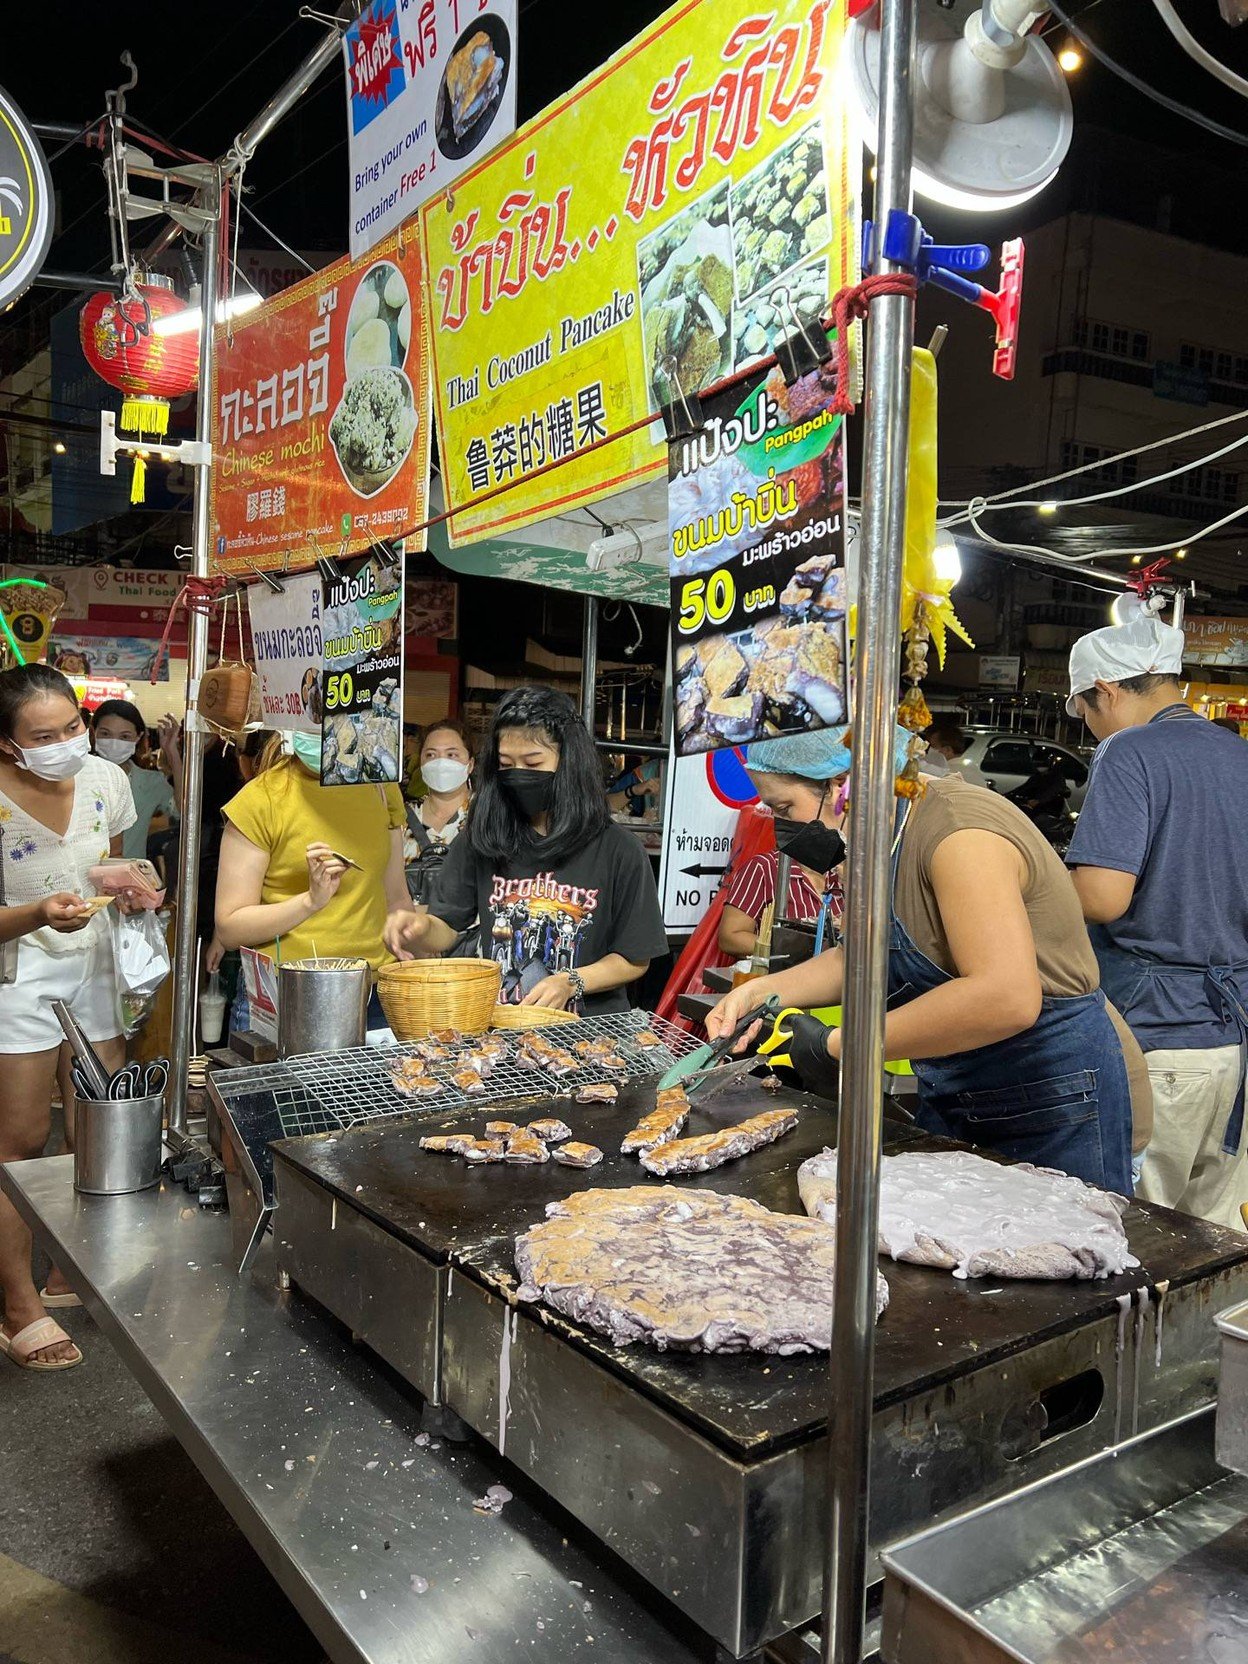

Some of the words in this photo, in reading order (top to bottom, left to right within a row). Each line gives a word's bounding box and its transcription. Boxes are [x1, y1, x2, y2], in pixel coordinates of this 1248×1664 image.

[355, 162, 380, 193] Bring
[381, 144, 403, 176] your
[404, 119, 428, 149] own
[355, 189, 399, 235] container
[400, 163, 426, 198] Free
[430, 149, 437, 173] 1
[447, 367, 479, 409] Thai
[488, 331, 552, 389] Coconut
[560, 290, 635, 353] Pancake
[221, 444, 275, 479] Chinese
[281, 423, 325, 462] mochi
[466, 382, 607, 491] 魯莽的糖果
[764, 409, 833, 453] Pangpah
[672, 467, 798, 559] ขนมบ้าบิ่น
[280, 530, 303, 542] sesame
[742, 514, 841, 567] มะพร้าวอ่อน
[113, 571, 168, 585] CHECK
[119, 585, 143, 596] Thai
[148, 586, 176, 597] Food
[368, 590, 398, 607] Pangpah
[679, 569, 736, 632] 50
[743, 584, 775, 611] บาท
[324, 616, 382, 660] ขนมบ้าบิ่น
[356, 655, 400, 674] มะพร้าวอ่อน
[326, 673, 353, 708] 50
[676, 828, 734, 852] ห้ามจอด
[489, 871, 599, 911] Brothers
[676, 890, 700, 906] NO
